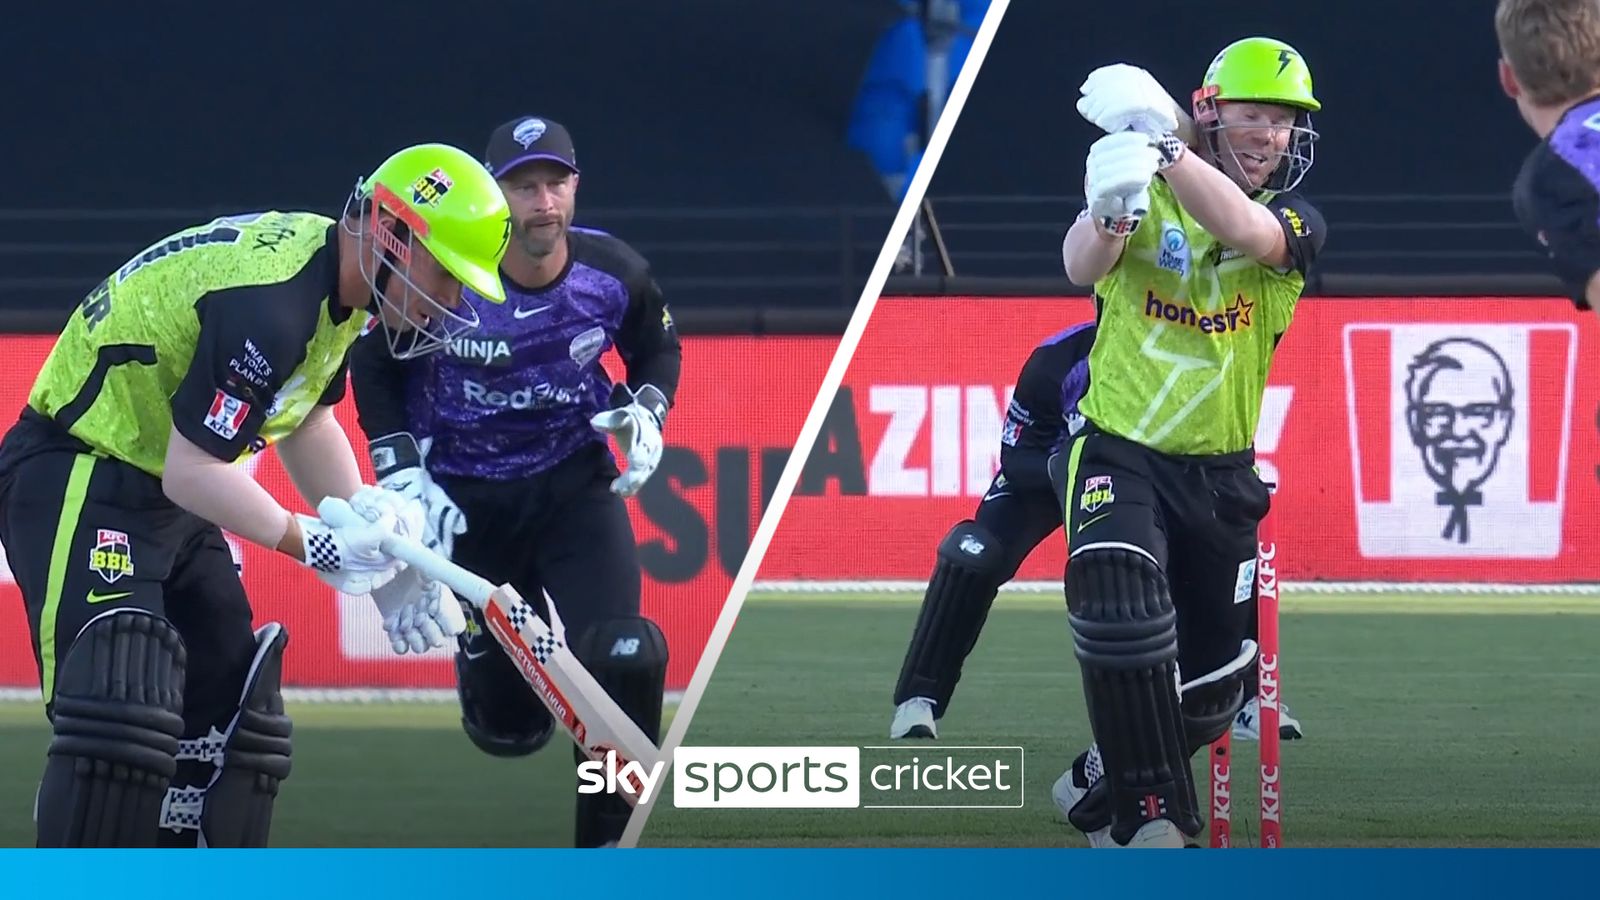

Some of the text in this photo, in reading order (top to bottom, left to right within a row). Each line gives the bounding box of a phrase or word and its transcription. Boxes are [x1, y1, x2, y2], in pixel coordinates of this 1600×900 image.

[413, 177, 441, 208] BBL
[446, 338, 511, 365] NINJA
[228, 358, 256, 382] PLAN
[209, 419, 233, 437] KFC
[92, 550, 133, 573] BBL
[1258, 542, 1277, 600] KFC
[610, 637, 640, 657] NB
[1260, 653, 1278, 711] KFC
[1213, 764, 1231, 822] KFC
[1261, 764, 1279, 824] KFC
